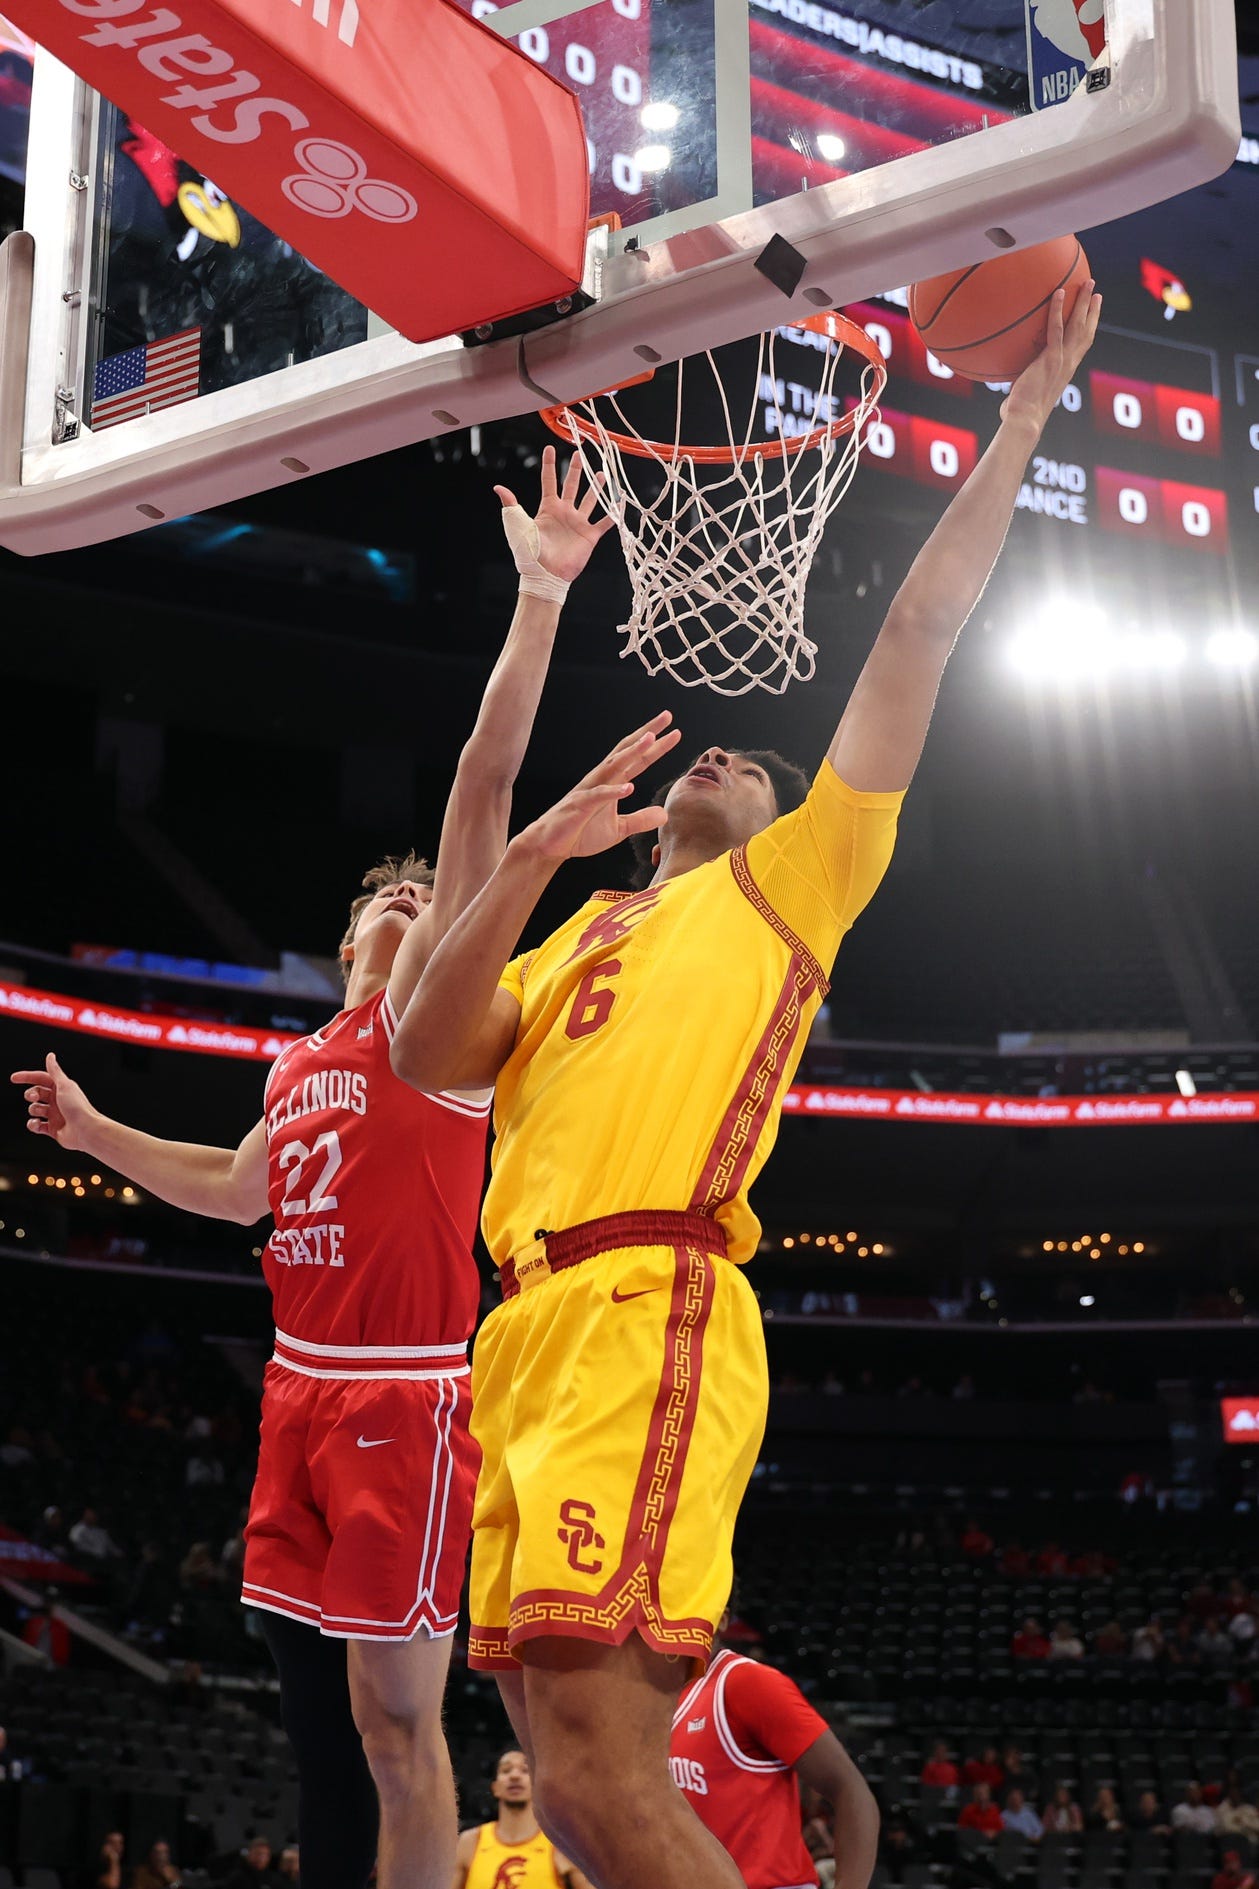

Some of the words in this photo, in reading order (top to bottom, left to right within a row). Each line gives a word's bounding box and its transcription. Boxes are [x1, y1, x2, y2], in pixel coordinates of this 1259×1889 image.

[565, 42, 596, 85] 0
[611, 64, 642, 106] 0
[1041, 66, 1081, 104] NBA
[612, 153, 642, 195] 0
[787, 382, 842, 424] THE
[1112, 392, 1142, 429] 0
[1175, 406, 1205, 443] 0
[866, 420, 896, 459] 0
[929, 439, 959, 478] 0
[1032, 456, 1087, 494] 2ND
[1016, 484, 1089, 525] ANCE
[1118, 487, 1148, 524] 0
[1181, 501, 1211, 537] 0
[564, 958, 623, 1041] 6
[265, 1069, 368, 1149] ILLINOIS
[278, 1130, 343, 1217] 22
[268, 1224, 345, 1267] STATE
[517, 1261, 534, 1278] FIGHT
[557, 1498, 606, 1575] SC
[668, 1756, 709, 1796] OIS
